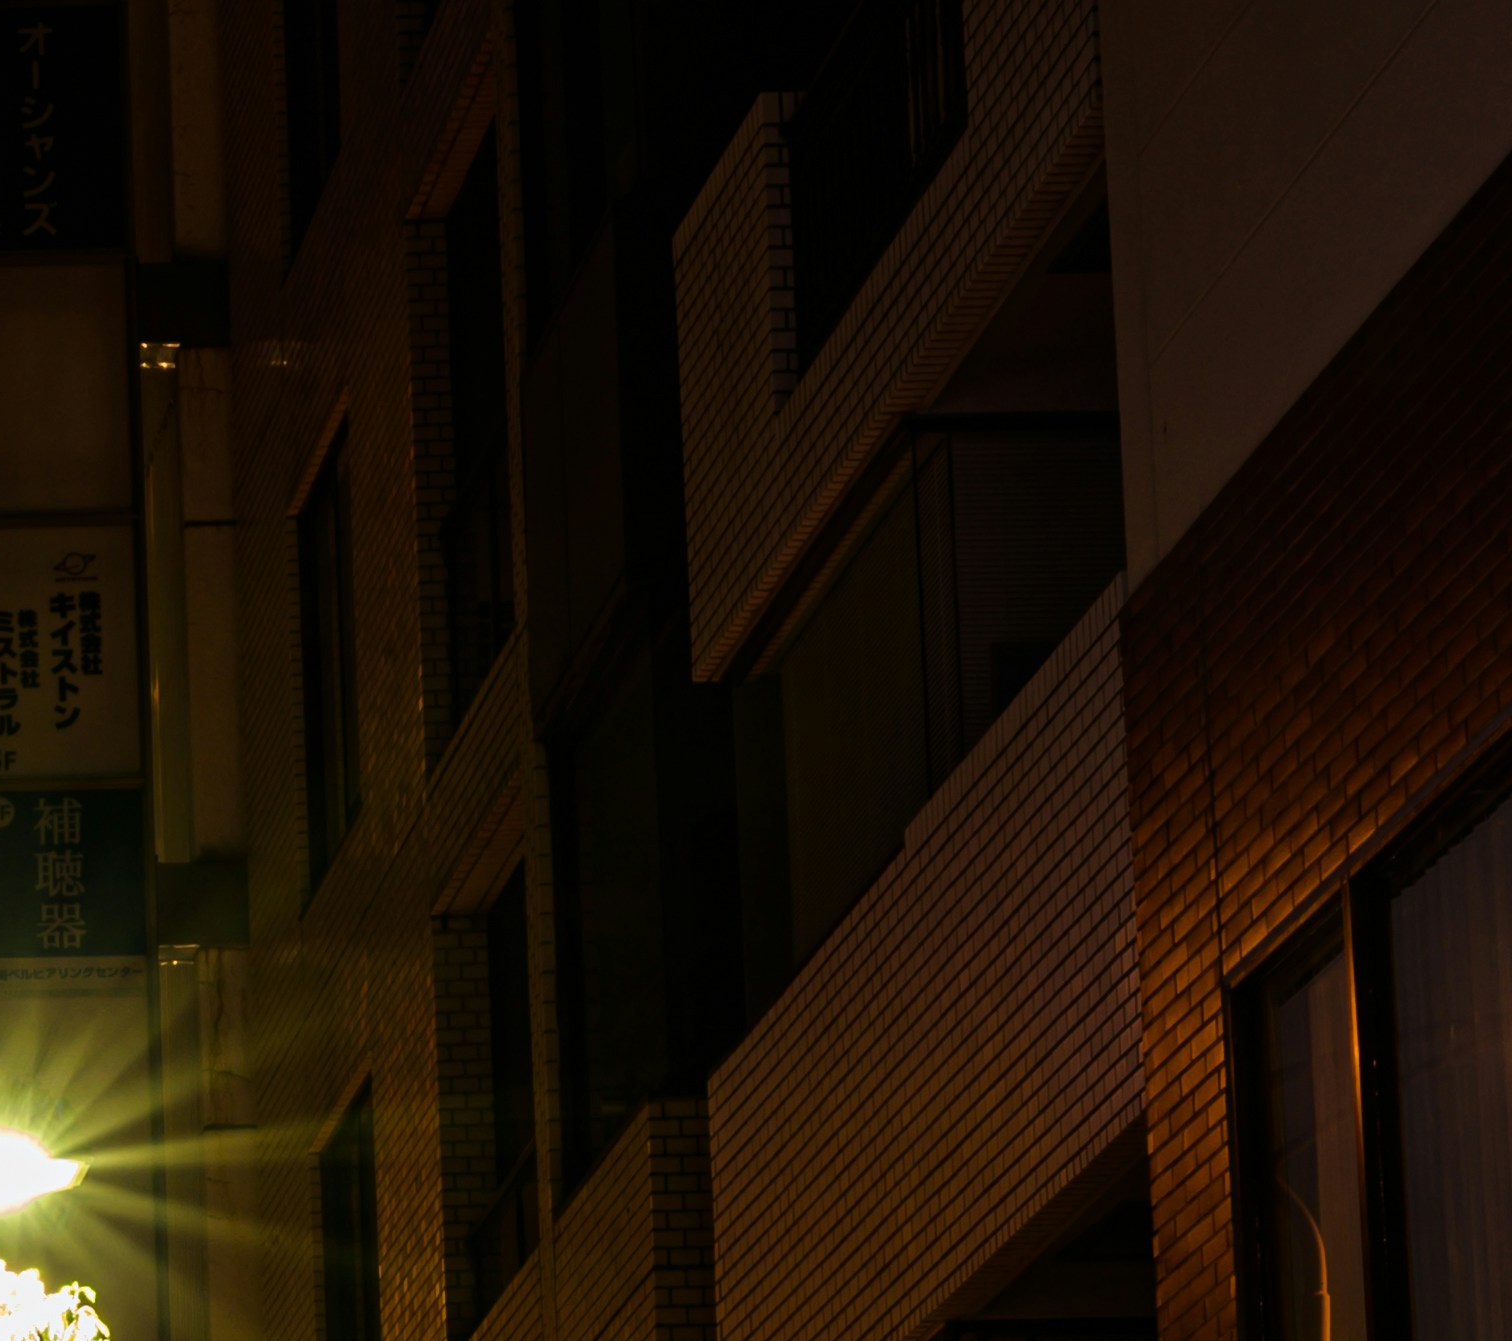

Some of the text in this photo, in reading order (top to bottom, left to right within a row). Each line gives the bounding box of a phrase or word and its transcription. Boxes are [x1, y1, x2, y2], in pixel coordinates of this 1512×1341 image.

[17, 20, 58, 237] オーシャンズ
[50, 593, 81, 730] キイストン
[78, 591, 103, 676] 株式会社
[32, 797, 88, 950] 補聴器
